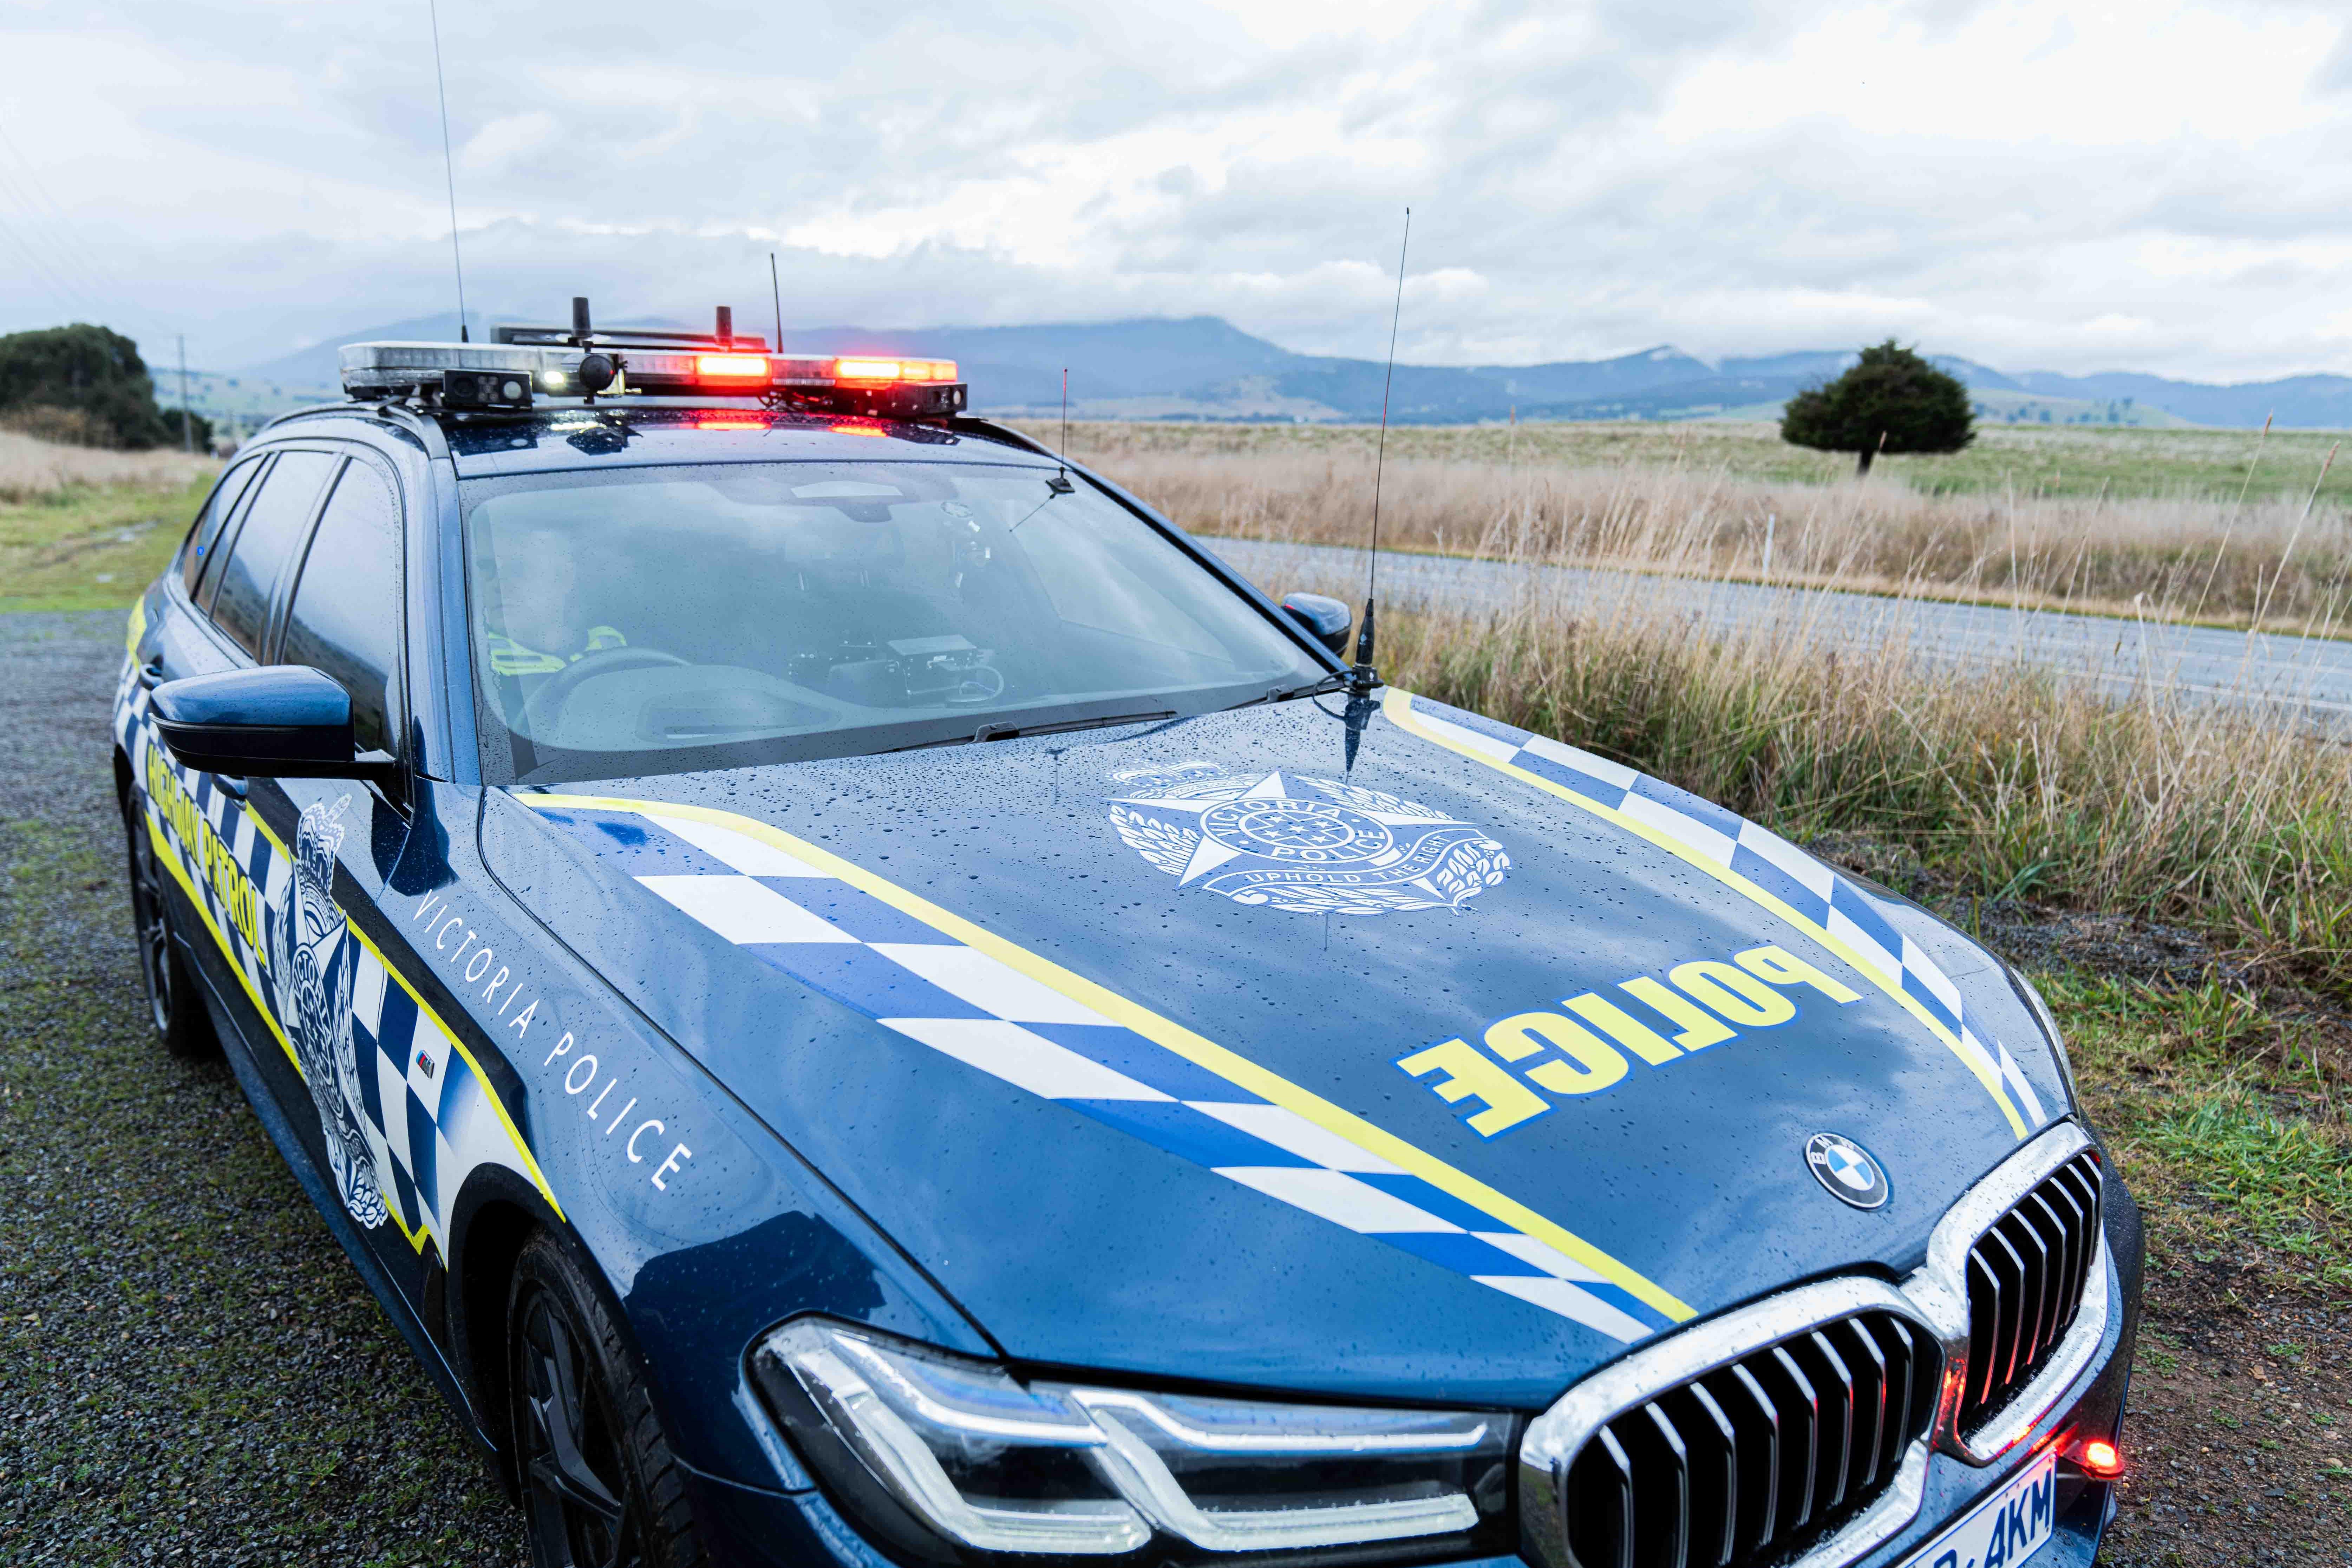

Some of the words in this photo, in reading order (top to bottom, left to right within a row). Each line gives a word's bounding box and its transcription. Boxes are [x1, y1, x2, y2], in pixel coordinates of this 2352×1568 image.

[1208, 801, 1341, 837] VICTORIA
[147, 743, 200, 866] HIGHWAY
[203, 819, 266, 971] PATROL
[1244, 872, 1361, 883] UPHOLD
[1371, 864, 1422, 881] THE
[1413, 835, 1451, 864] RIGHT
[1271, 830, 1386, 861] POLICE
[413, 889, 540, 1039] VICTORIA
[543, 1031, 692, 1191] POLICE
[1810, 1136, 1855, 1165] BMW
